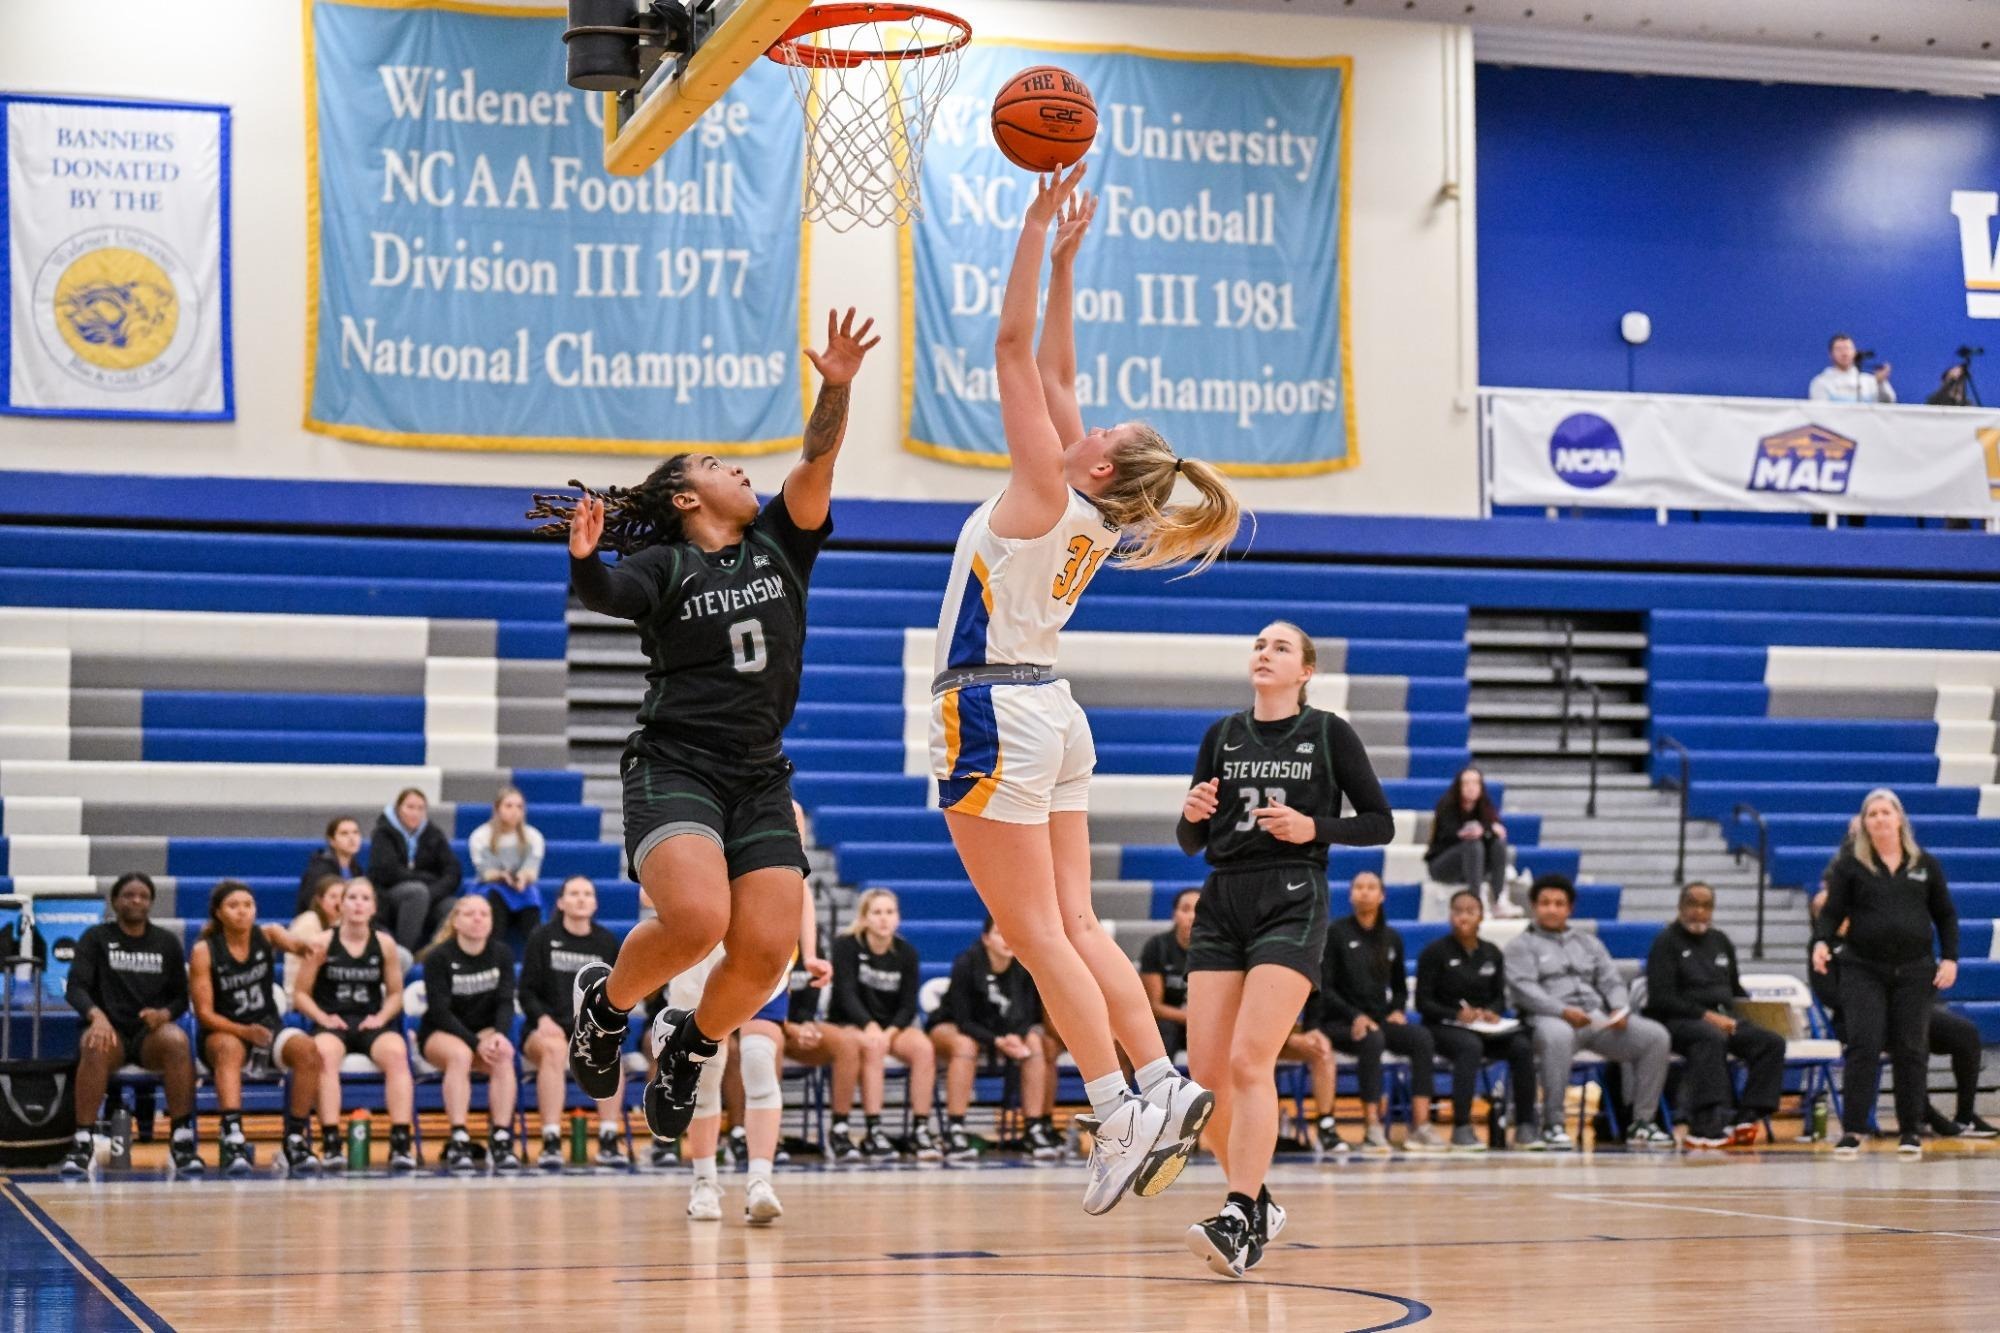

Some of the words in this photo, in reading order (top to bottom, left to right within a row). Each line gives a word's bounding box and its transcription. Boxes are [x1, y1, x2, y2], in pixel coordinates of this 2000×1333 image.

[377, 65, 573, 126] Widener
[1022, 73, 1055, 93] THE
[56, 127, 175, 152] BANNERS
[1109, 103, 1319, 182] University
[52, 158, 180, 183] DONATED
[381, 148, 540, 210] NCAA
[551, 155, 734, 217] Football
[69, 189, 98, 210] BY
[110, 190, 164, 212] THE
[1105, 185, 1276, 246] Football
[370, 231, 558, 295] Division
[574, 244, 641, 297] III
[656, 248, 751, 299] 1977
[1136, 274, 1198, 326] III
[1213, 280, 1297, 332] 1981
[340, 315, 529, 385] National
[545, 331, 787, 404] Champions
[1117, 357, 1338, 428] Champions
[1555, 448, 1623, 474] NCAA
[1753, 457, 1848, 491] MAC
[680, 575, 786, 620] STEVENSON
[1052, 535, 1110, 605] 31
[729, 618, 767, 673] 0
[1223, 761, 1312, 780] STEVENSON
